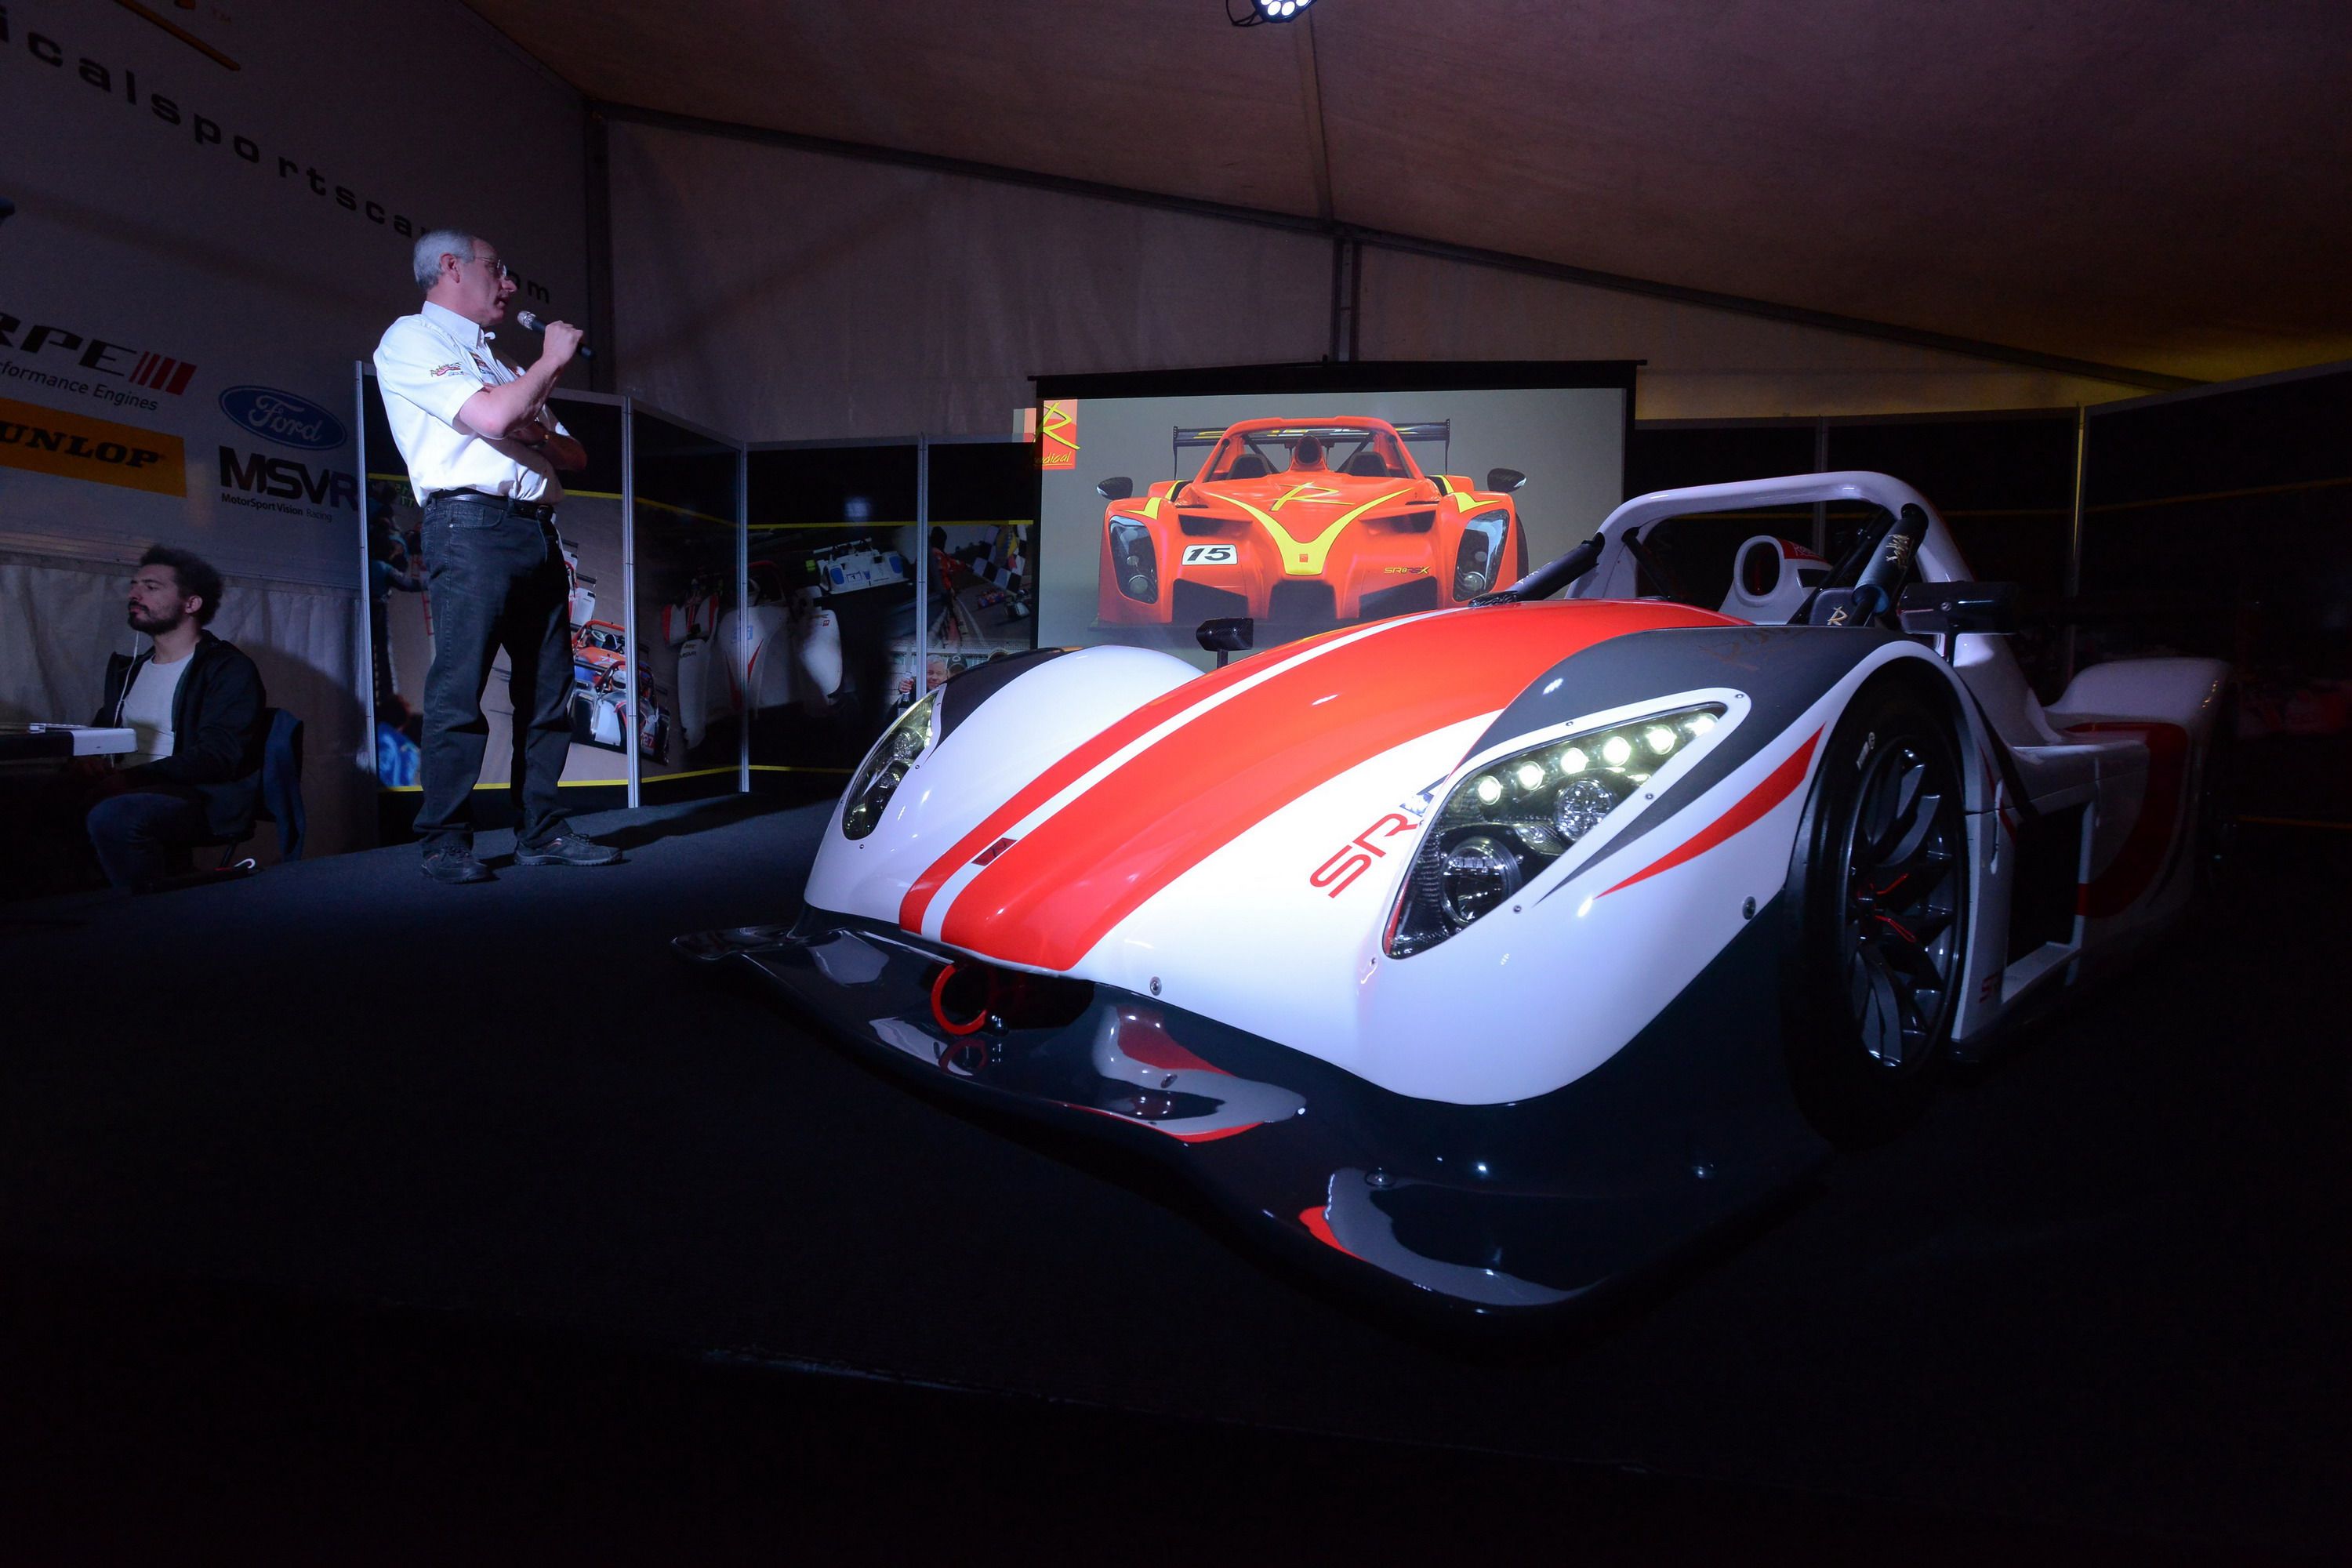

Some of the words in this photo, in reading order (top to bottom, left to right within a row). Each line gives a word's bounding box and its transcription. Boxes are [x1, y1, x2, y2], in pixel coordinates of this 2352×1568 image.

[0, 361, 89, 394] formance
[93, 383, 158, 411] Engines
[248, 394, 324, 442] Ford
[219, 445, 358, 512] MSVR
[276, 503, 303, 516] Vision
[1187, 547, 1232, 561] 15
